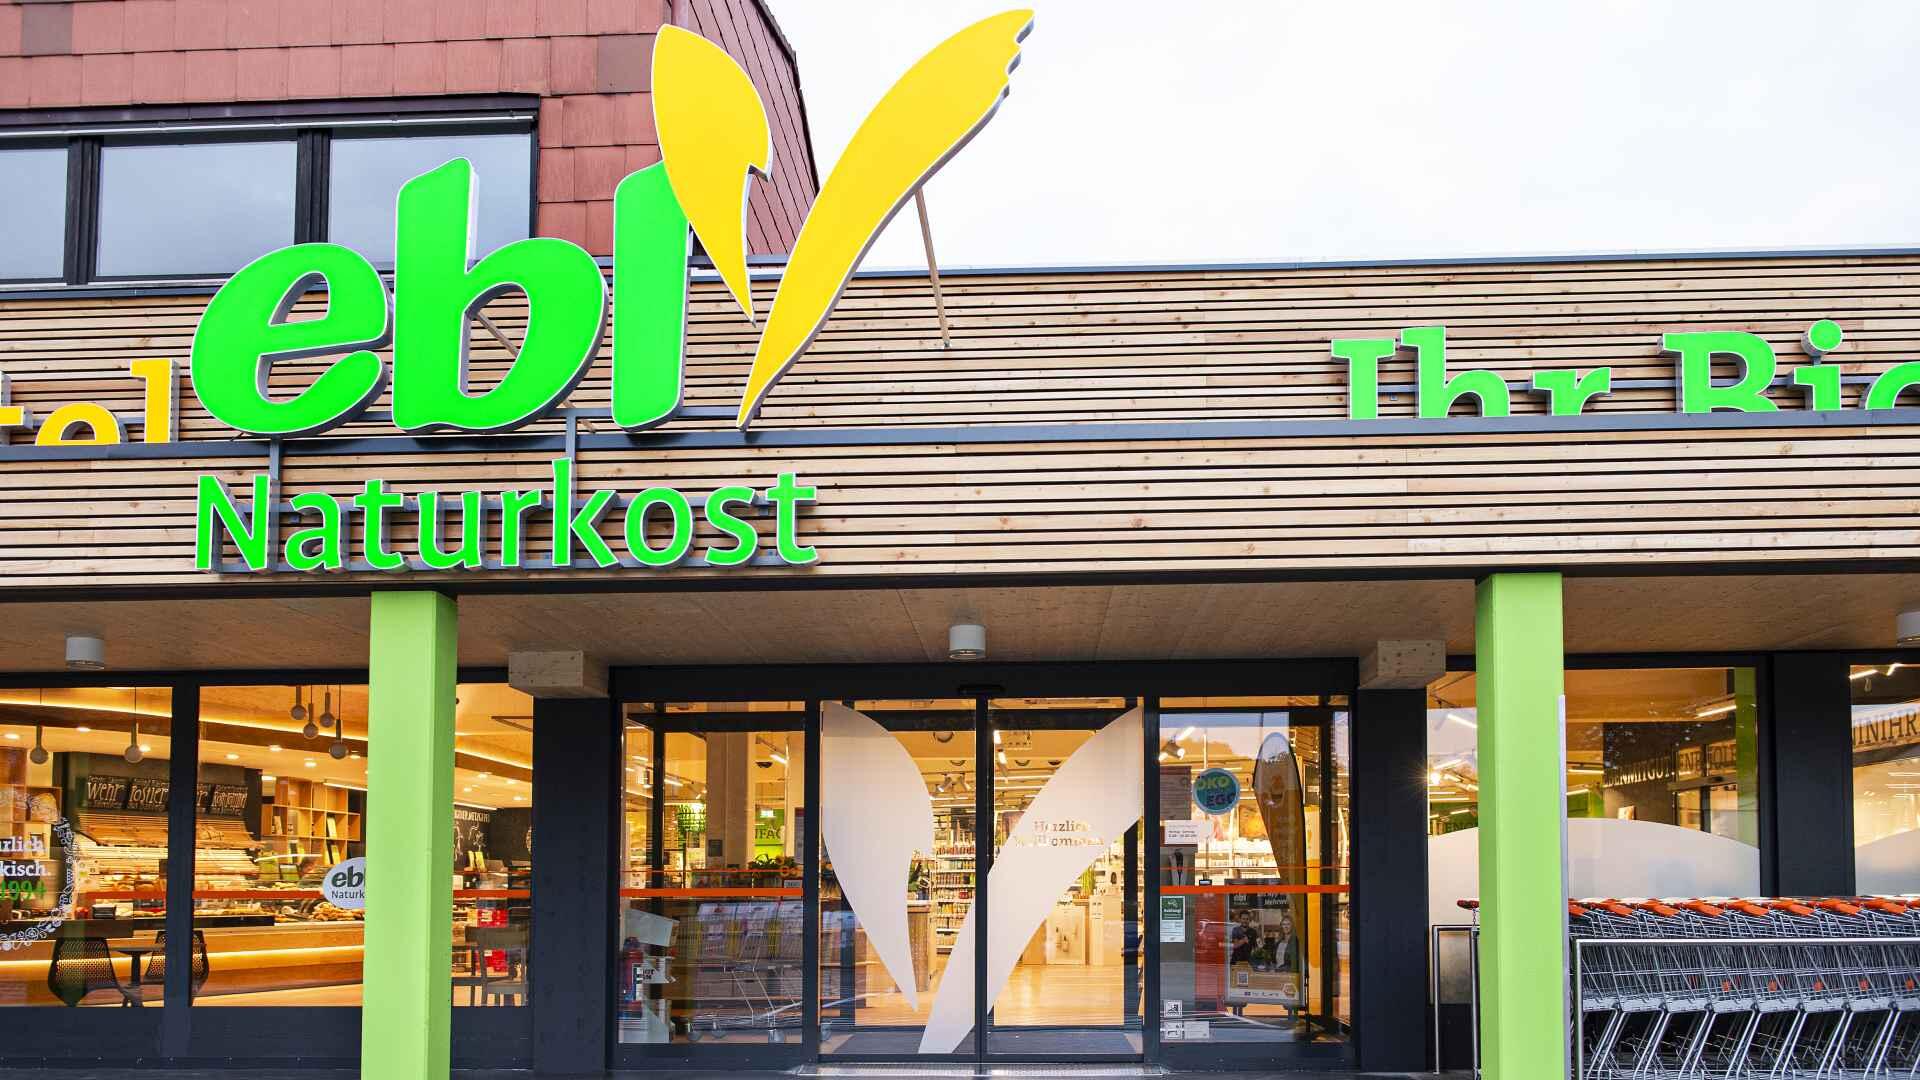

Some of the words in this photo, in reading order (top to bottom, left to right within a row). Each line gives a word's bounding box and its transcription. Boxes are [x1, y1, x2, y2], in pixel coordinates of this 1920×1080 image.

[190, 157, 690, 434] ebl
[1332, 325, 1611, 420] Ihr
[195, 458, 818, 571] Naturkost
[331, 865, 367, 888] eb
